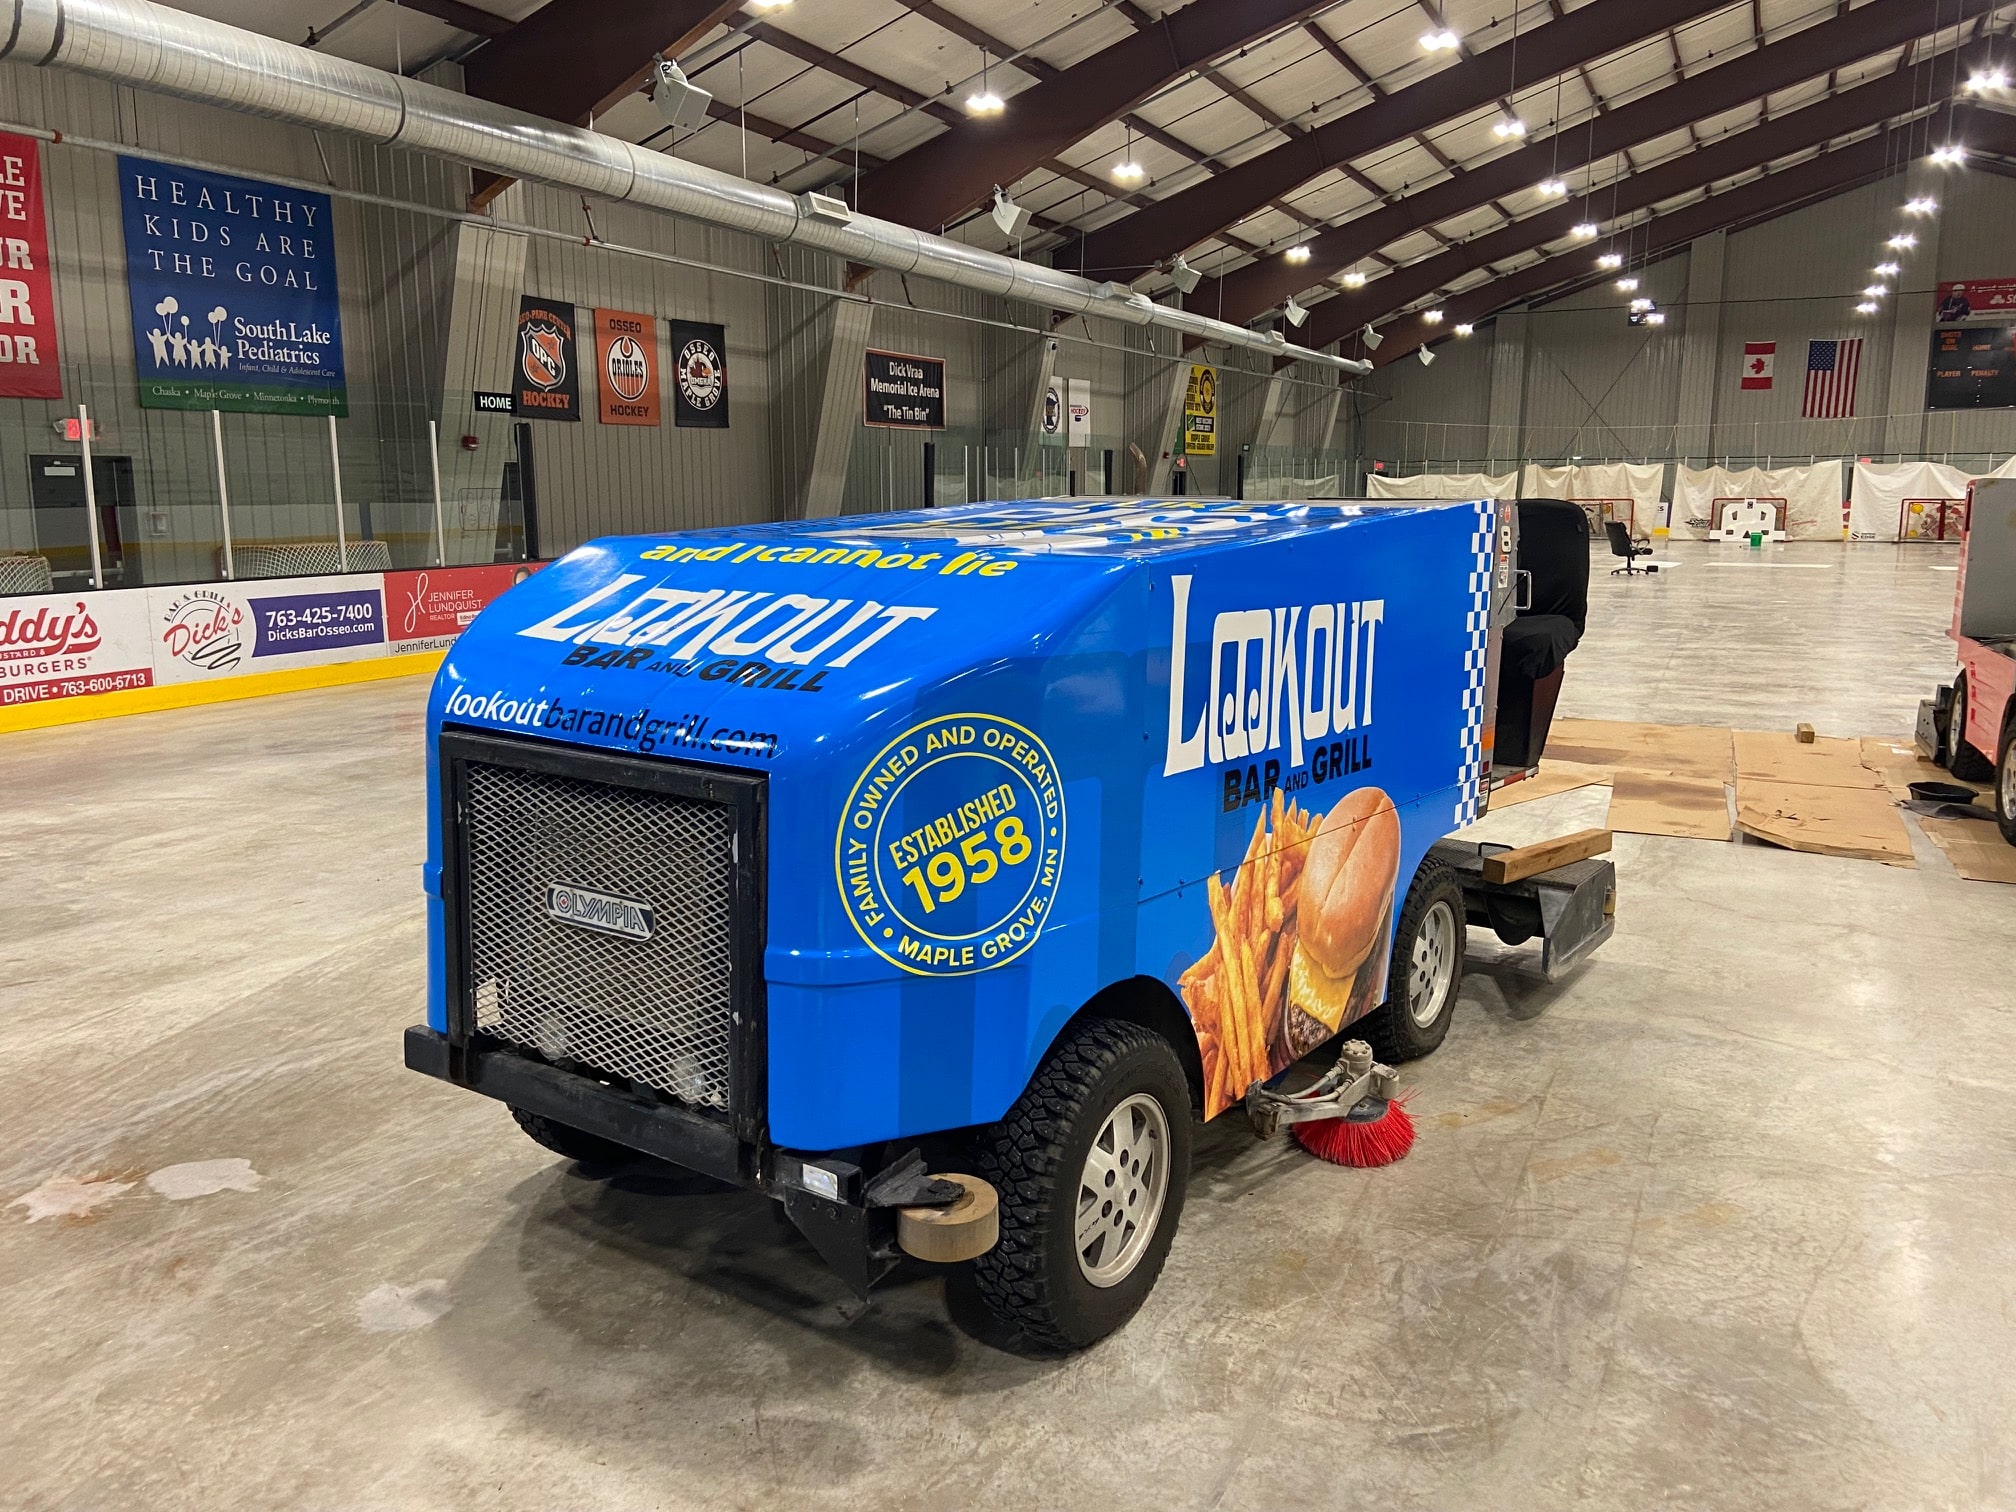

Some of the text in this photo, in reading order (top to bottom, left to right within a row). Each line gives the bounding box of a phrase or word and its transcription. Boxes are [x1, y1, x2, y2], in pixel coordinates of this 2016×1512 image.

[135, 174, 317, 228] HEALTHY
[144, 214, 315, 259] KIDS ARE
[148, 249, 318, 291] THE GOAL
[234, 316, 331, 345] South Lake
[609, 318, 642, 334] OSSEO
[236, 339, 320, 365] Pediatrics
[532, 339, 556, 376] OPC
[684, 342, 716, 361] OSSEO
[261, 364, 280, 374] Child
[321, 368, 336, 378] Care
[612, 357, 644, 379] ORIOLES
[889, 361, 923, 379] Dick Vraa
[1970, 369, 1999, 377] PENALTY
[152, 386, 181, 397] Chaska
[219, 390, 242, 401] Grove
[253, 391, 297, 403] Minnetonka
[307, 395, 340, 406] Plymoth
[522, 390, 570, 409] HOCKEY
[680, 368, 721, 407] MAPLE GROVE
[870, 378, 940, 398] Memorial Ice Arena
[480, 395, 512, 410] HOME
[610, 404, 650, 417] HOCKEY
[902, 406, 914, 420] Tin
[639, 542, 746, 564] and
[756, 546, 942, 571] cannot
[938, 551, 1019, 577] lie
[428, 589, 474, 602] JENNIFER
[428, 599, 483, 613] LUNDQUIST
[266, 603, 373, 628] 763-425-7400
[430, 613, 456, 621] REALTOR
[516, 573, 939, 669] LOOKOUT
[163, 602, 244, 657] Dick's
[267, 621, 375, 642] DicksBarOsseo.com
[0, 650, 37, 660] STARD
[562, 645, 838, 693] BAR AND GRILL
[1163, 574, 1385, 778] LOOKOUT
[3, 673, 146, 703] DRIVE 763-600-6713
[445, 685, 778, 759] lookoutbarandgrill.com
[1222, 734, 1373, 813] BAR AND GRILL
[848, 726, 1060, 927] FAMILY OWNED AND OPERATED
[888, 783, 1017, 871] ESTABLISHED
[902, 816, 1033, 915] 1958
[556, 890, 646, 932] OLYMPIA
[898, 848, 1058, 967] MAPLE GROVE, MN
